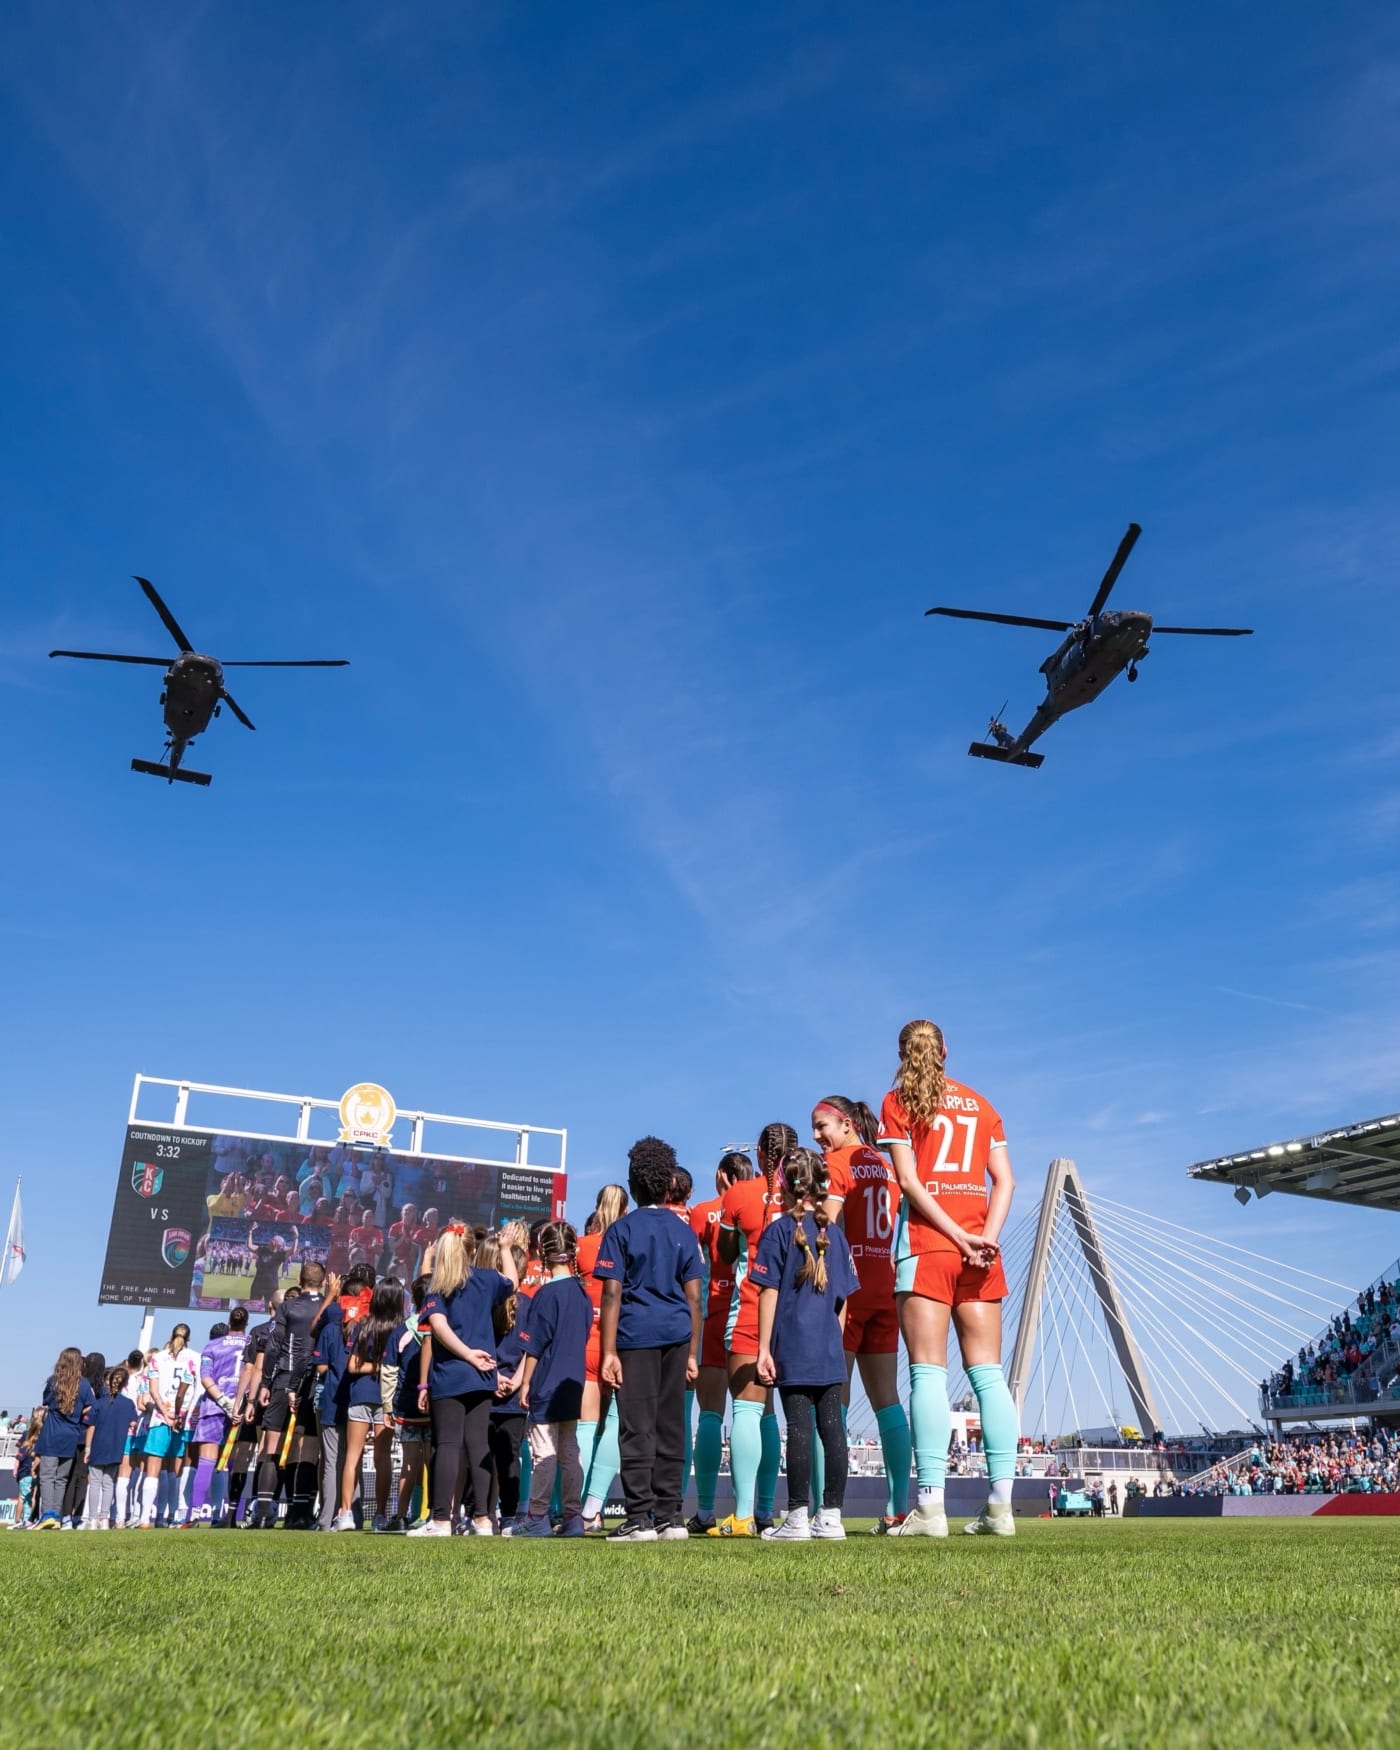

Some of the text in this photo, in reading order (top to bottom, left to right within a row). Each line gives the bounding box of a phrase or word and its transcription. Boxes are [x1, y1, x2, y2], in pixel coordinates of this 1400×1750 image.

[353, 1130, 379, 1138] CPKC
[172, 1136, 180, 1144] TO
[181, 1137, 208, 1147] KICKOFF
[932, 1114, 978, 1173] 27
[156, 1145, 181, 1158] 3:32
[502, 1172, 532, 1182] Dedicated
[540, 1177, 553, 1185] mak
[501, 1182, 506, 1190] it
[507, 1184, 525, 1192] easier
[533, 1185, 544, 1193] live
[501, 1192, 530, 1201] healthiest
[863, 1186, 892, 1239] 18
[171, 1367, 183, 1390] 5
